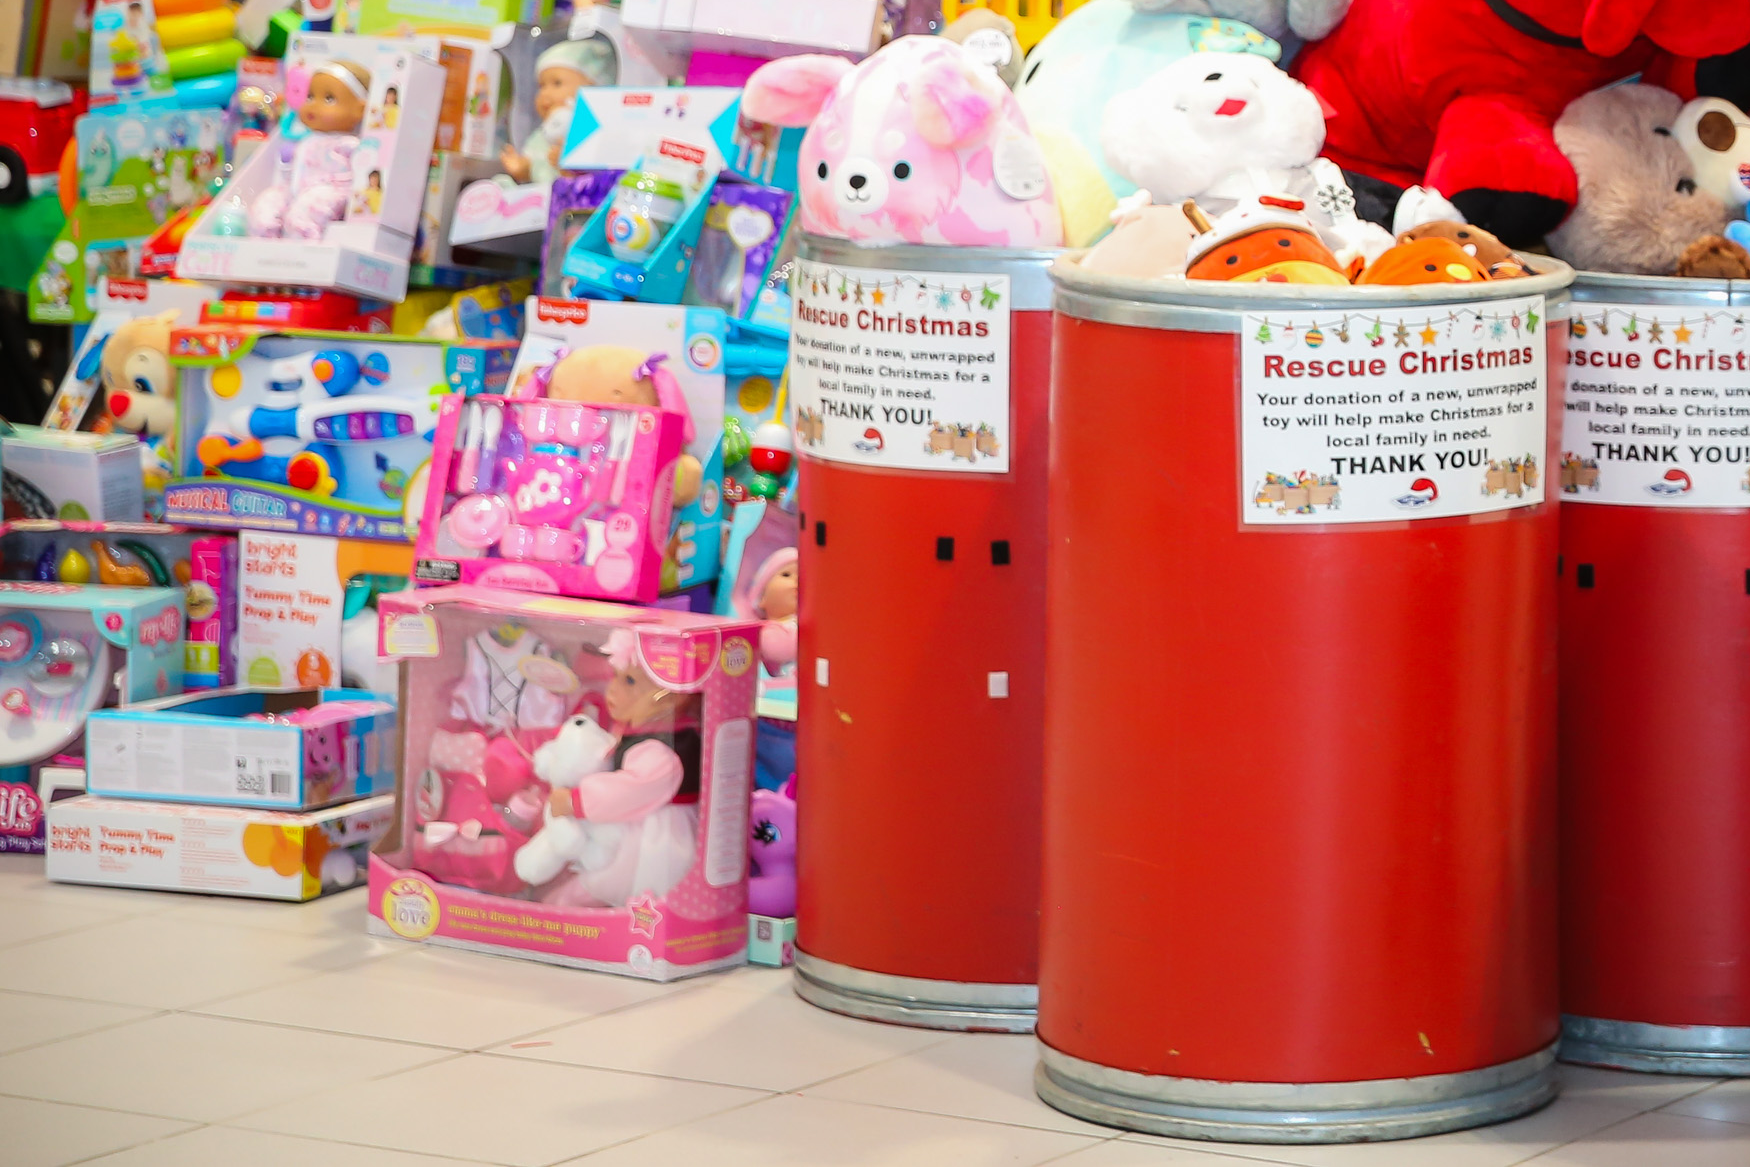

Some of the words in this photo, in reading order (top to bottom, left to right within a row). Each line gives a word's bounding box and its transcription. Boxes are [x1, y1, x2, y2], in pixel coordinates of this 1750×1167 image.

[798, 299, 849, 328] Rescue
[857, 309, 990, 337] Christmas
[810, 338, 847, 354] donation
[850, 344, 861, 356] of
[876, 348, 906, 361] new,
[911, 350, 995, 365] unwrapped
[1264, 355, 1386, 378] Rescue
[1399, 346, 1533, 375] Christmas
[1567, 349, 1641, 368] scue
[822, 360, 840, 374] help
[845, 363, 874, 375] make
[879, 366, 950, 381] Christmas
[955, 370, 975, 382] for
[981, 374, 991, 383] a
[819, 378, 840, 391] local
[843, 383, 876, 398] family
[881, 386, 893, 397] in
[897, 388, 936, 400] need.
[1257, 393, 1298, 406] Your
[1304, 388, 1382, 405] donation
[1389, 390, 1404, 404] of
[1411, 393, 1420, 402] a
[1426, 390, 1462, 404] new,
[1467, 378, 1538, 399] unwrapped
[1571, 380, 1637, 395] donation
[1643, 383, 1658, 396] of
[1664, 387, 1674, 396] a
[1680, 386, 1719, 398] new,
[821, 399, 874, 421] THANK
[883, 407, 933, 425] YOU!
[1263, 415, 1289, 429] toy
[1297, 413, 1328, 427] will
[1334, 413, 1372, 428] help
[1379, 411, 1424, 425] make
[1430, 405, 1502, 422] Christmas
[1508, 401, 1524, 415] for
[1526, 402, 1534, 412] a
[1595, 402, 1628, 416] help
[1634, 404, 1677, 416] make
[1327, 433, 1370, 448] local
[1376, 431, 1427, 448] family
[1433, 429, 1448, 443] in
[1453, 427, 1491, 441] need.
[1588, 421, 1626, 434] local
[1631, 422, 1681, 438] family
[1687, 424, 1702, 436] in
[1331, 453, 1426, 475] THANK
[1435, 448, 1490, 470] YOU!
[1592, 442, 1678, 463] THANK
[1689, 446, 1750, 463] YOU!
[167, 487, 230, 512] MUSICAL
